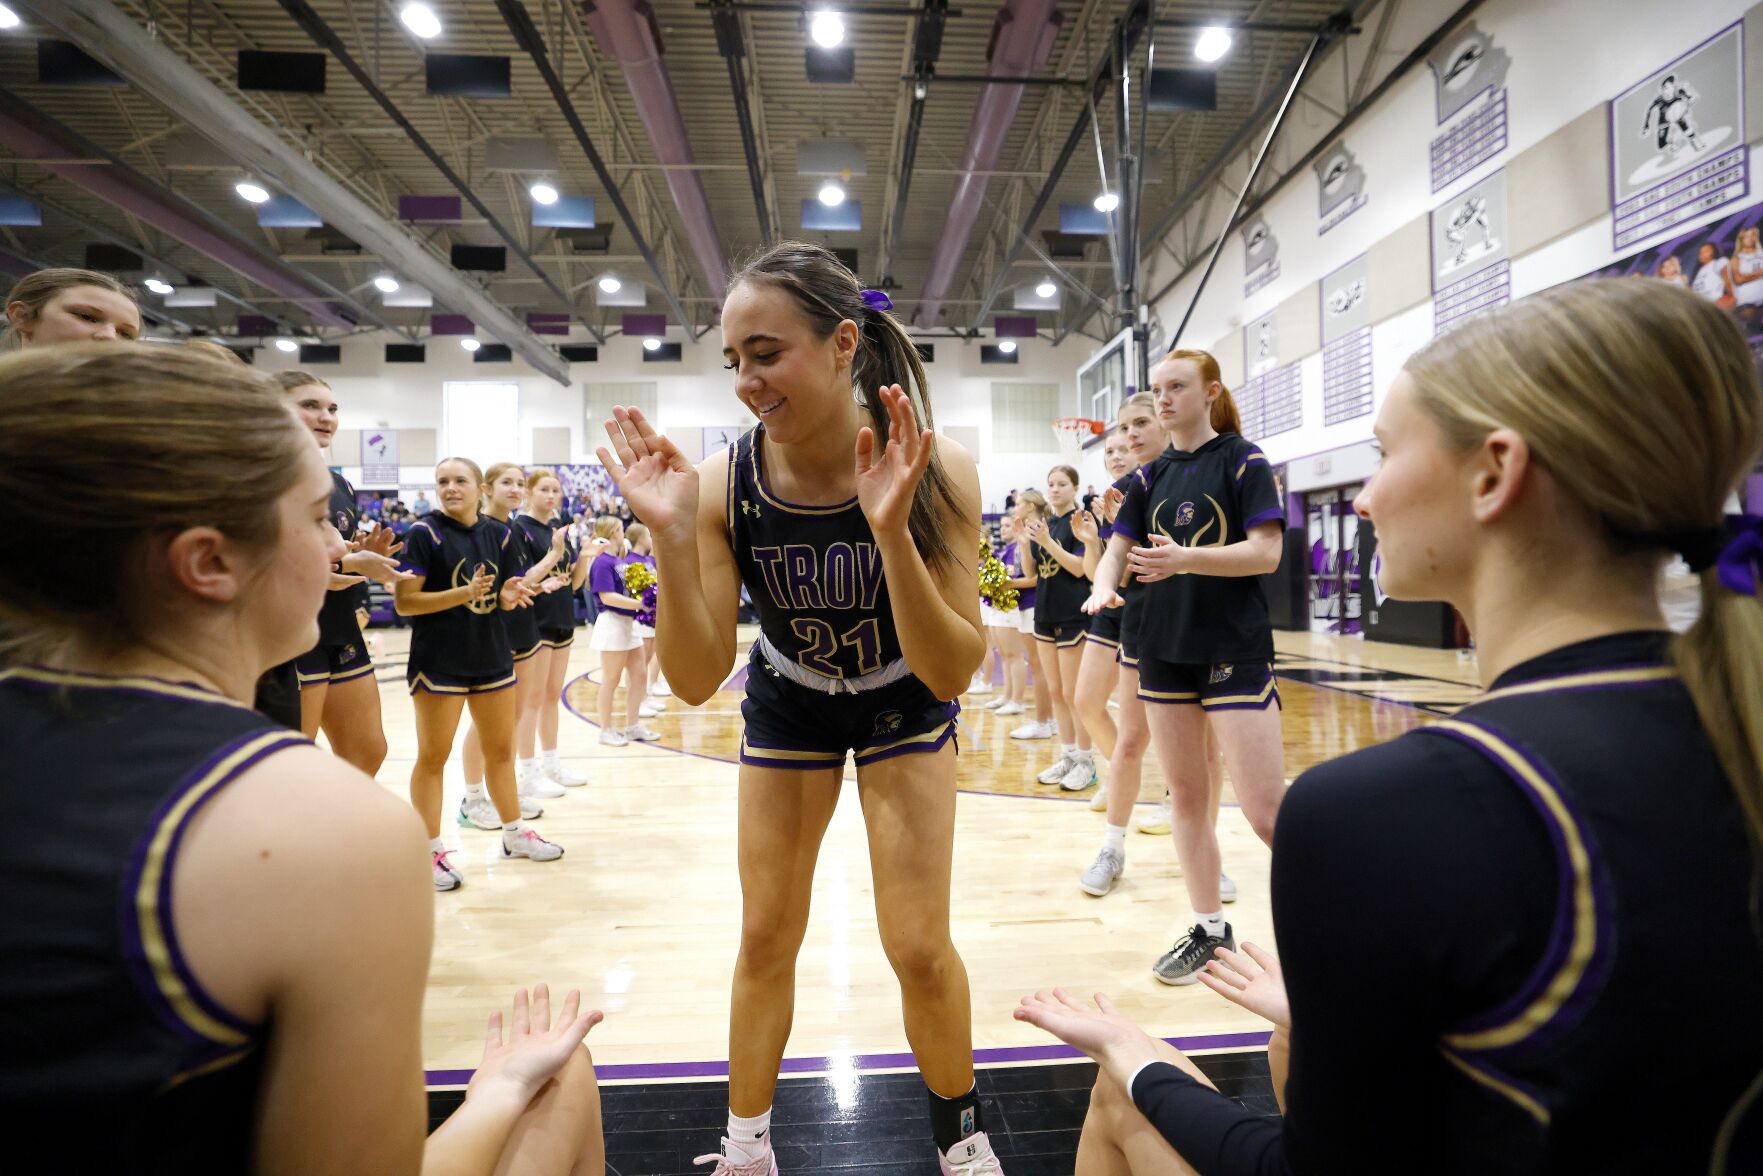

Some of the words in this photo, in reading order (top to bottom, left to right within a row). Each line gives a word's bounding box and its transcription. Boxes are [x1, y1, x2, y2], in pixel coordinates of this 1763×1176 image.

[1698, 152, 1741, 178] CHAMPS
[1698, 168, 1741, 194] CHAMPS
[751, 541, 882, 610] TROY
[790, 617, 883, 680] 21
